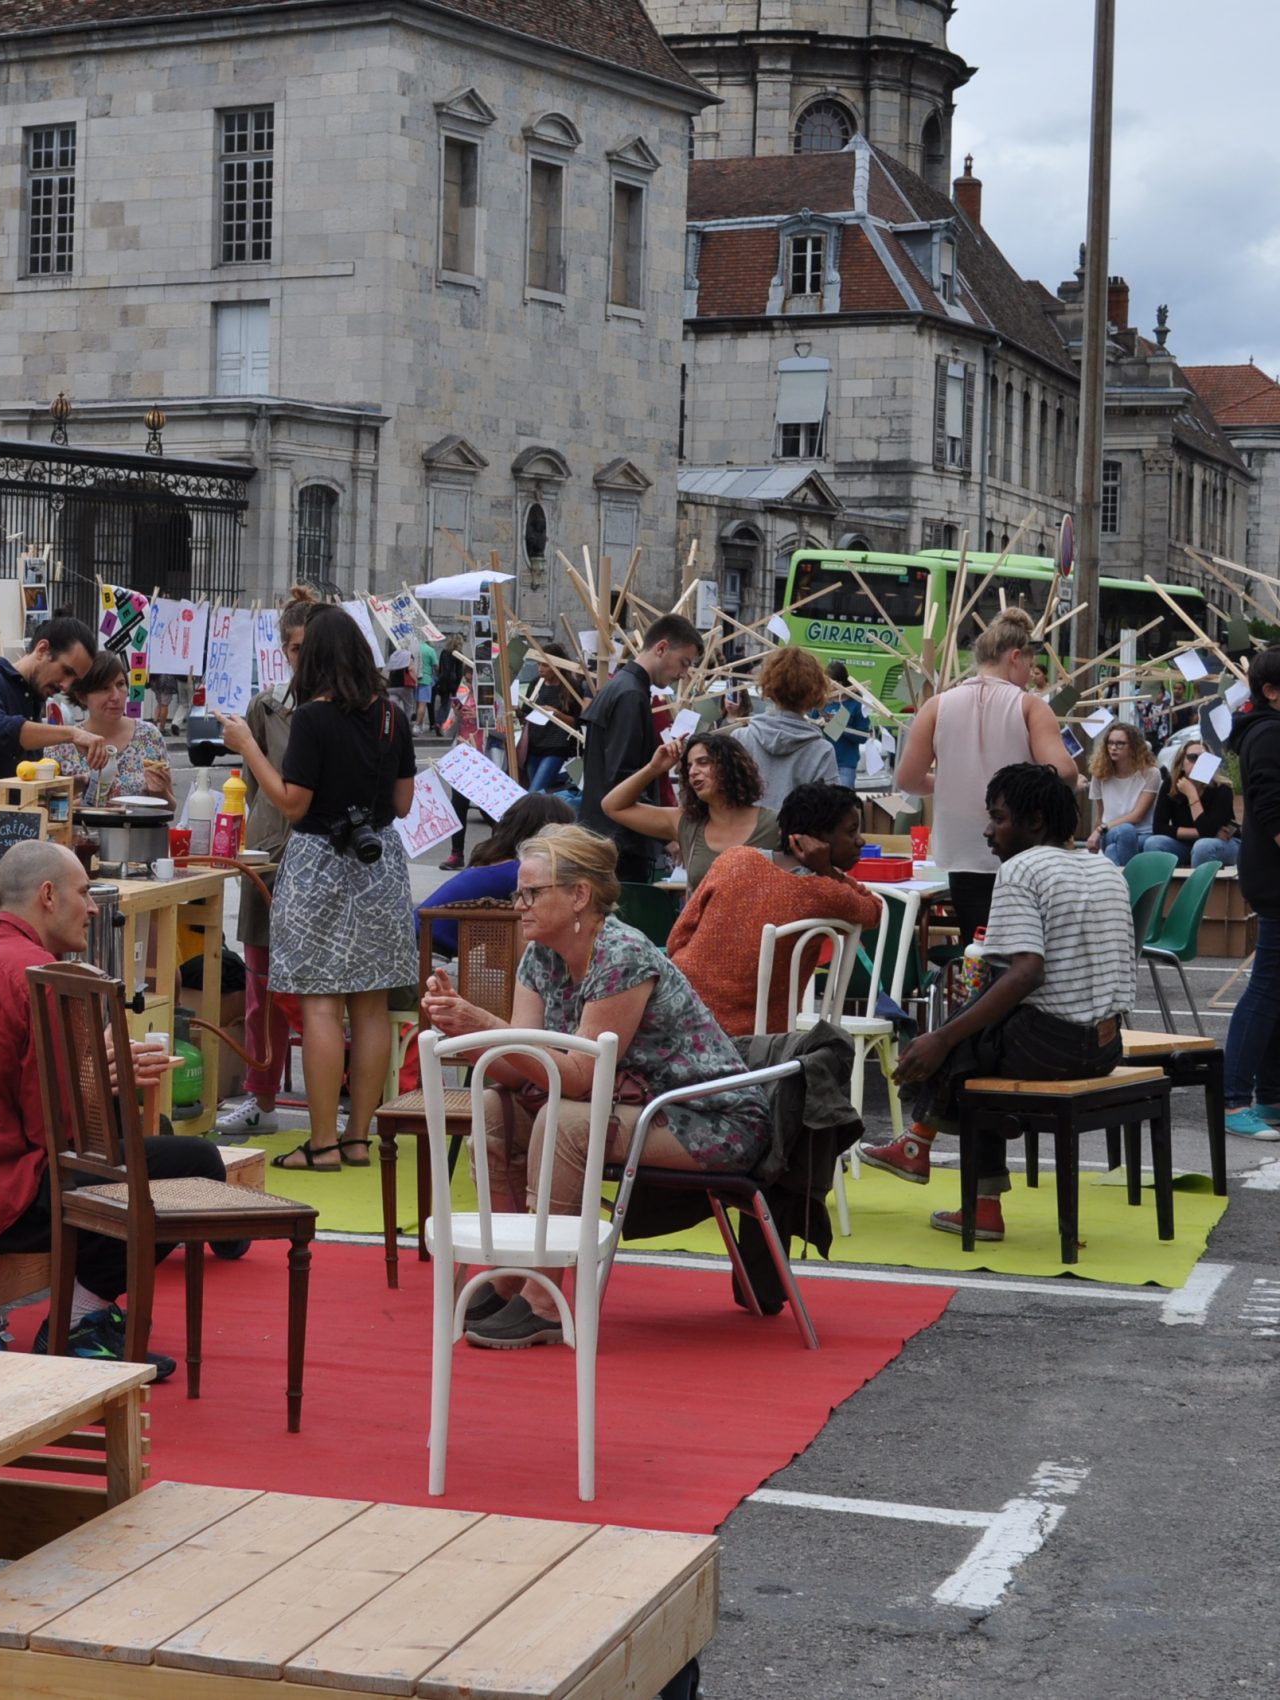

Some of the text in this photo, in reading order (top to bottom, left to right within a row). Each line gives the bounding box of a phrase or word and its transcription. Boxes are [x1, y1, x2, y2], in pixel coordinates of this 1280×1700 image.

[258, 616, 274, 642] AU
[827, 614, 885, 623] SETRA
[808, 622, 904, 647] GIRARDOT
